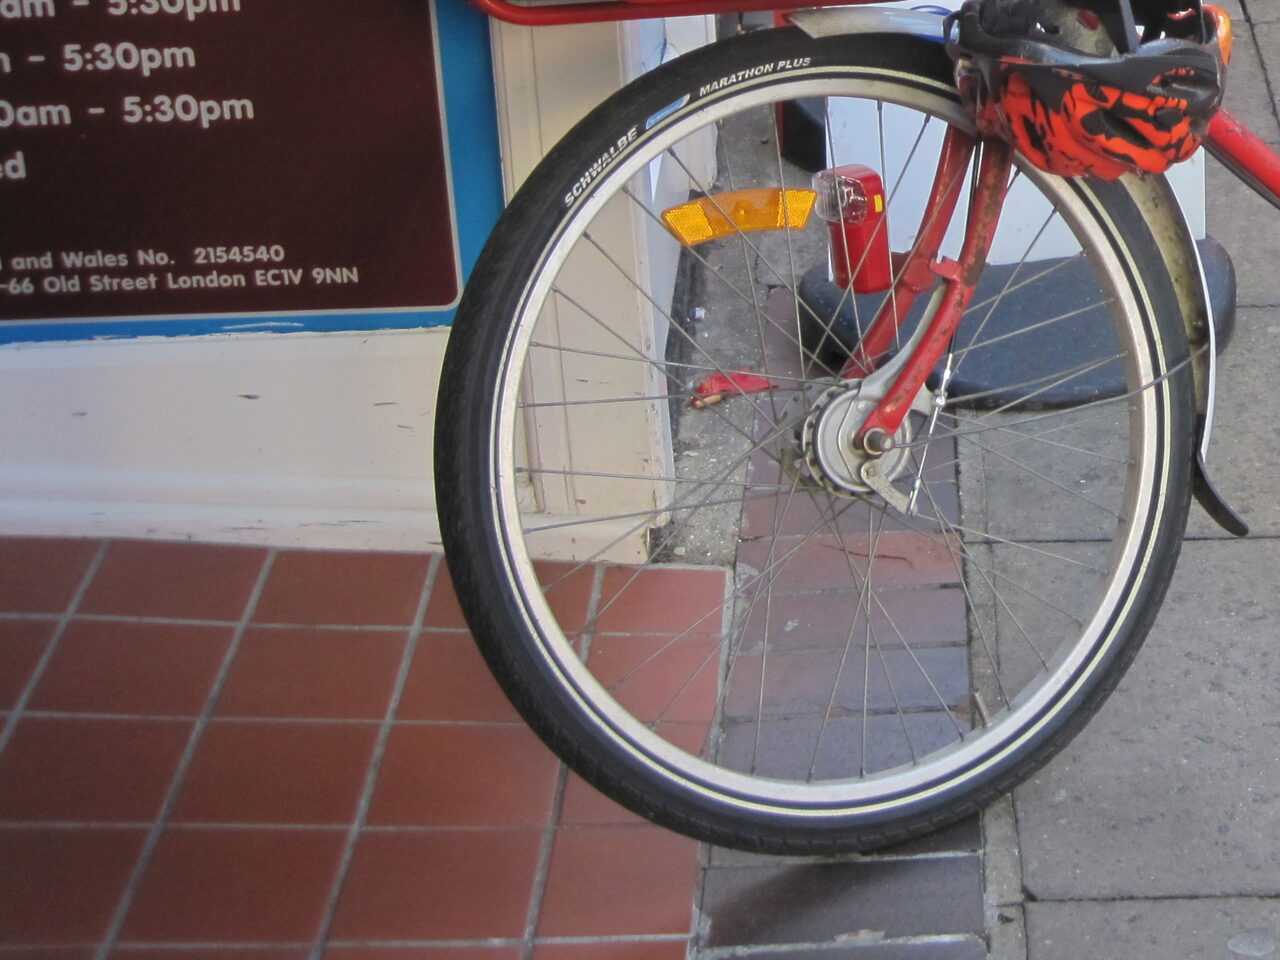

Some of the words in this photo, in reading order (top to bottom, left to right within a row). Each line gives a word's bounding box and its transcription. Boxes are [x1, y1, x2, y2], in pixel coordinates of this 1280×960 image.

[64, 42, 196, 77] 5:30pm
[699, 62, 775, 97] MARATHON
[776, 57, 812, 71] PLUS
[123, 94, 254, 128] 5:30pm
[564, 127, 638, 208] SCHWALBE
[12, 252, 52, 270] and
[61, 249, 128, 268] Wales
[138, 249, 175, 265] No.
[194, 244, 285, 264] 2154540
[44, 275, 80, 293] Old
[90, 273, 157, 291] Street
[168, 270, 246, 289] London
[255, 268, 303, 286] EC1V
[312, 266, 358, 284] 9NN
